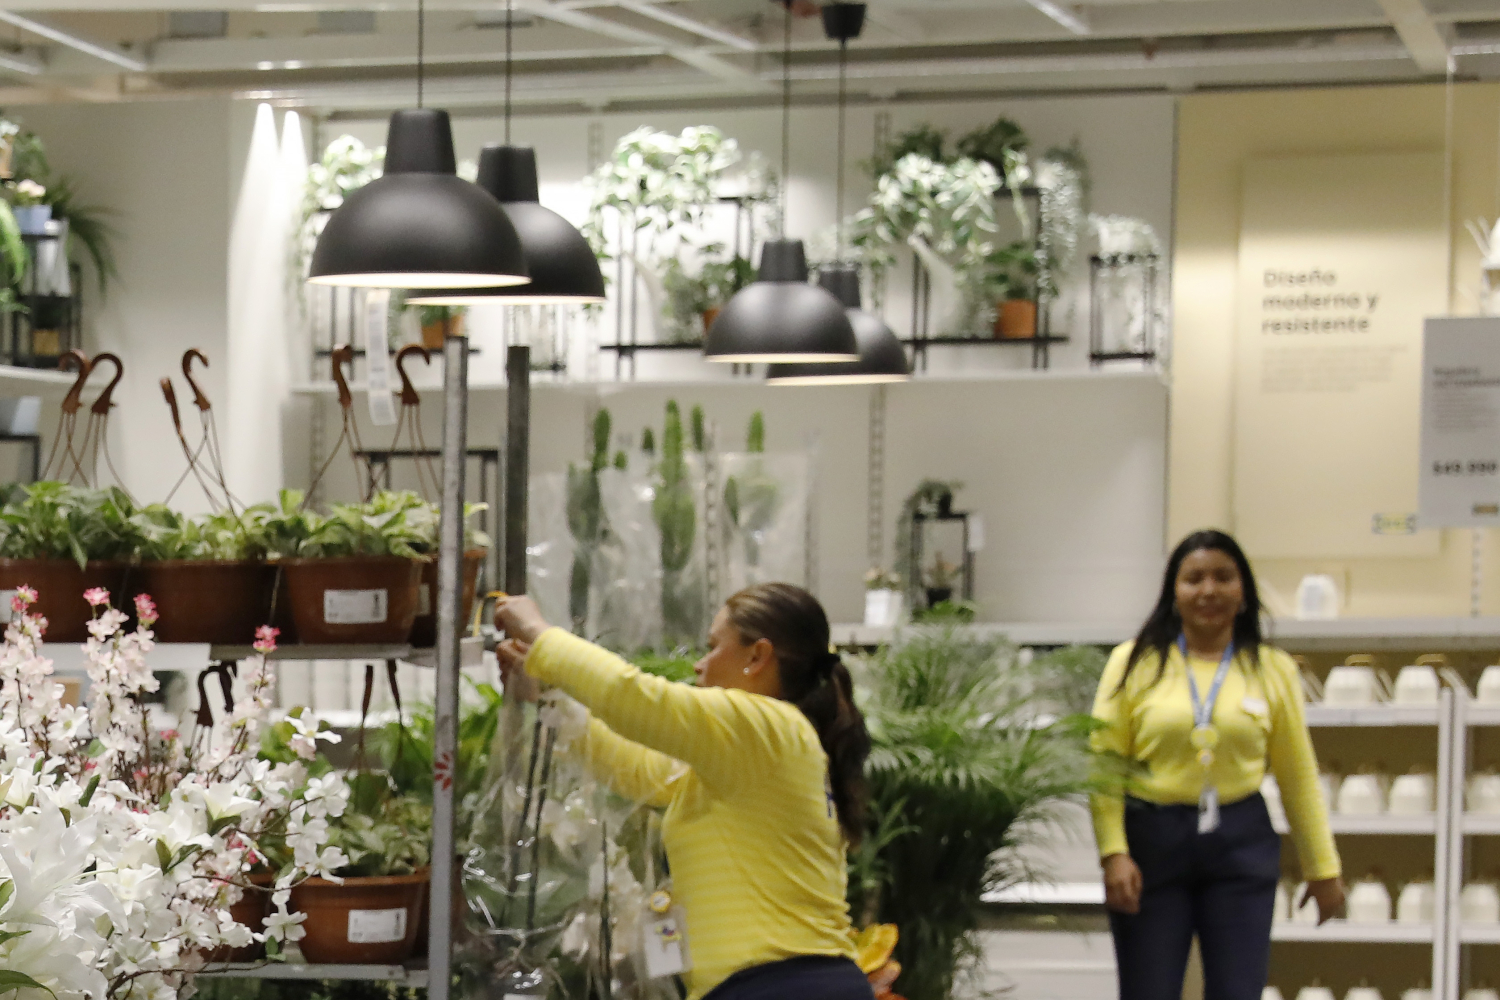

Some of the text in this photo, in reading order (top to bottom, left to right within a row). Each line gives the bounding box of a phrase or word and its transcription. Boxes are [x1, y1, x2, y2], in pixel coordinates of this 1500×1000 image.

[1263, 267, 1337, 287] Diseño
[1262, 292, 1380, 313] moderno y
[1261, 315, 1371, 334] resistente
